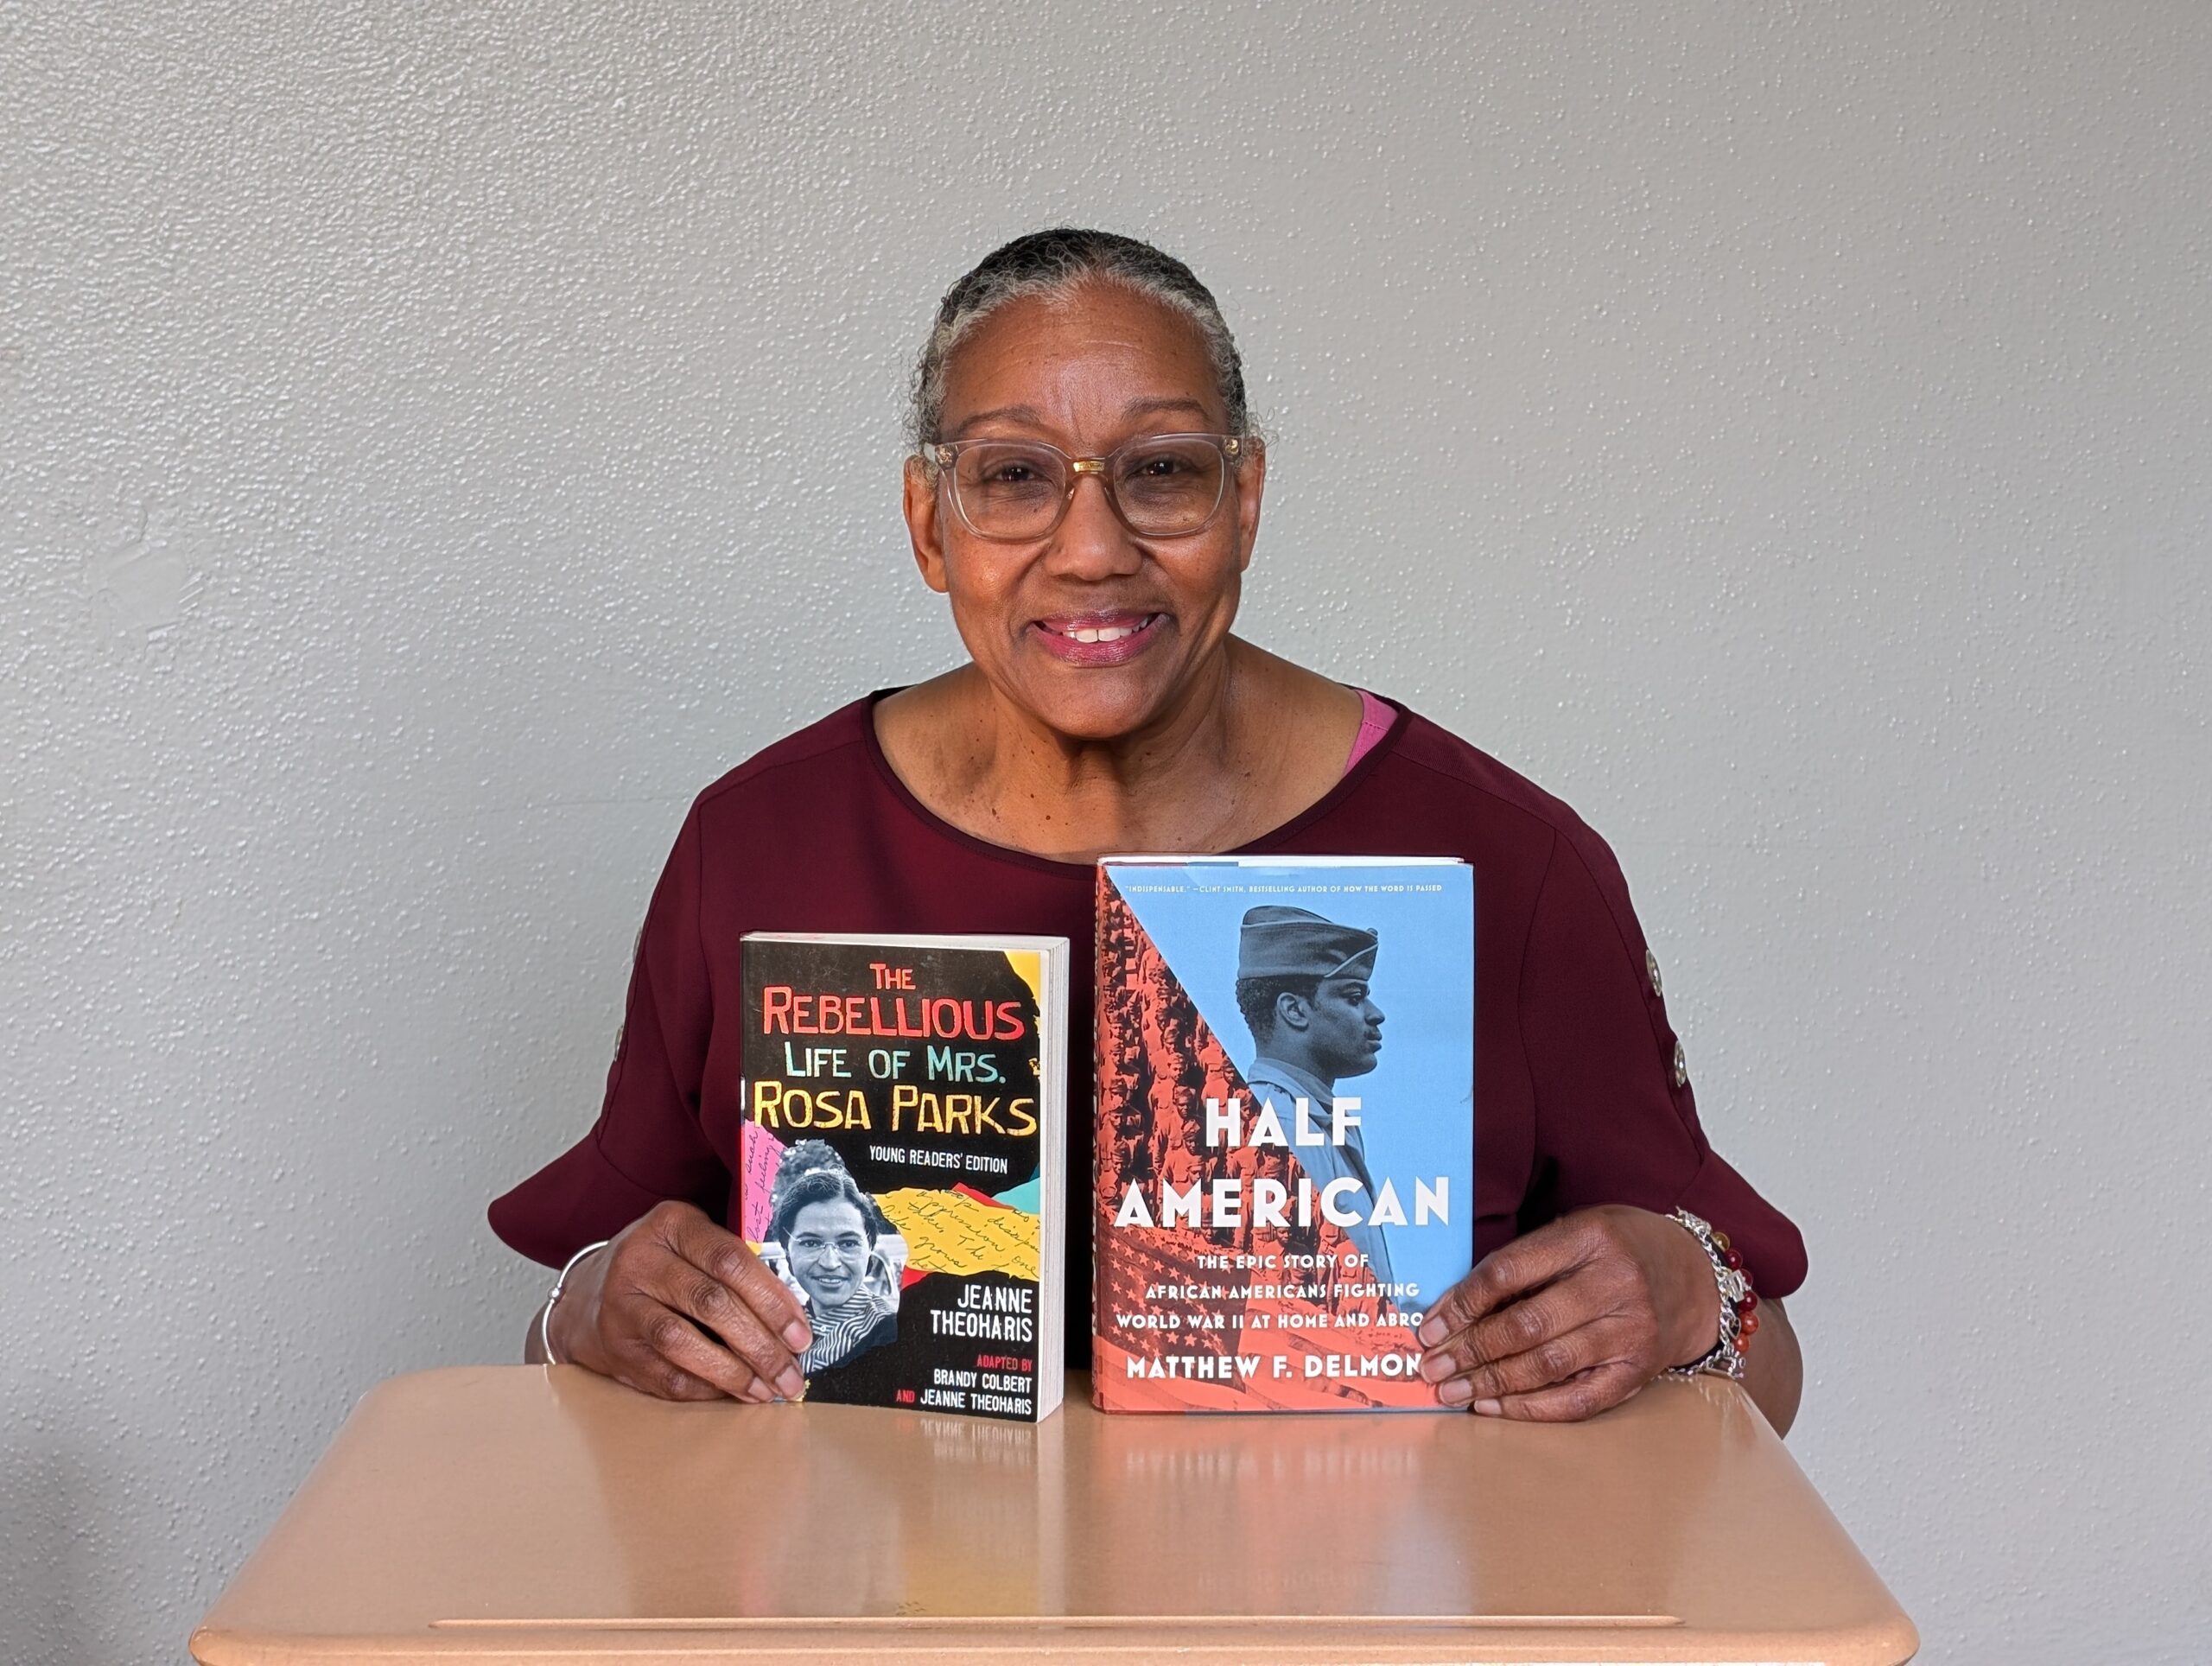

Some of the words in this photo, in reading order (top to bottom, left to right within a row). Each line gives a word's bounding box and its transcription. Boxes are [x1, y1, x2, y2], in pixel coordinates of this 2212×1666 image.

[869, 963, 916, 990] THE
[763, 986, 1026, 1041] REBELLIOUS
[784, 1040, 852, 1078] LIFE
[868, 1048, 911, 1079] OF
[926, 1045, 1007, 1084] MRS.
[753, 1080, 872, 1130] ROSA
[892, 1084, 1038, 1136] PARKS
[1205, 1097, 1362, 1148] HALF
[869, 1145, 906, 1163] YOUNG
[909, 1149, 963, 1169] READERS'
[965, 1154, 1008, 1174] EDITION
[1113, 1176, 1449, 1228] AMERICAN
[1197, 1255, 1229, 1269] THE
[1236, 1255, 1276, 1269] EPIC
[1283, 1254, 1338, 1269] STORY
[1344, 1253, 1369, 1269] OF
[957, 1283, 1033, 1314] JEANNE
[1145, 1283, 1222, 1300] AFRICAN
[1228, 1283, 1326, 1300] AMERICANS
[1333, 1282, 1420, 1299] FIGHTING
[930, 1309, 1033, 1343] THEOHARIS
[1116, 1313, 1181, 1329] WORLD
[1187, 1313, 1225, 1329] WAR
[1232, 1314, 1244, 1329] II
[1250, 1314, 1271, 1329] AT
[1277, 1313, 1328, 1329] HOME
[1333, 1313, 1370, 1328] AND
[1376, 1312, 1424, 1327] ABRO
[976, 1355, 1019, 1370] ADAPTED
[1020, 1359, 1033, 1372] BY
[1126, 1355, 1261, 1379] MATTHEW
[1273, 1355, 1294, 1378] F.
[1305, 1352, 1422, 1377] DELMON
[933, 1368, 977, 1389] BRANDY
[982, 1373, 1033, 1394] COLBERT
[895, 1389, 916, 1404] AND
[919, 1389, 966, 1408] JEANNE
[969, 1393, 1033, 1415] THEOHARIS
